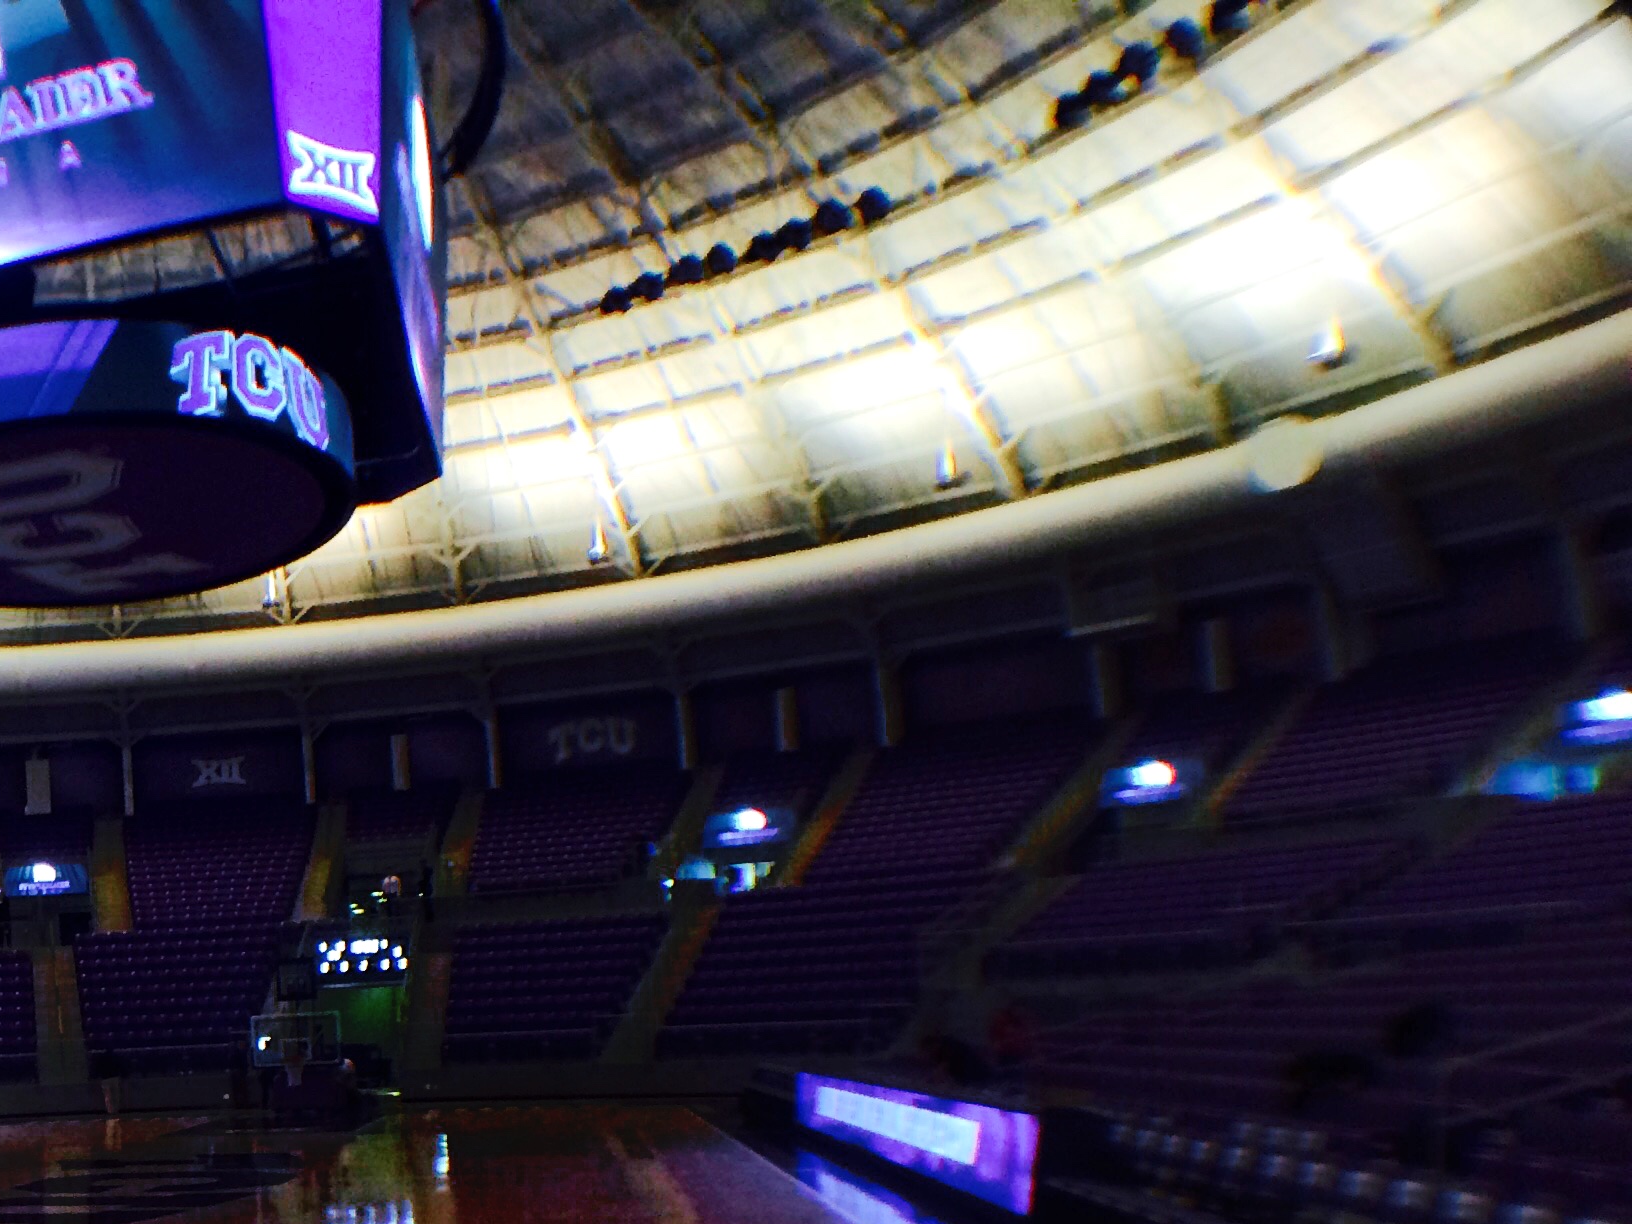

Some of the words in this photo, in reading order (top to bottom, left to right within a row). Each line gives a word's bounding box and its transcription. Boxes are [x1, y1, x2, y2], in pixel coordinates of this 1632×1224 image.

[170, 330, 329, 450] TCU
[548, 717, 637, 764] TCU
[191, 756, 246, 788] XII
